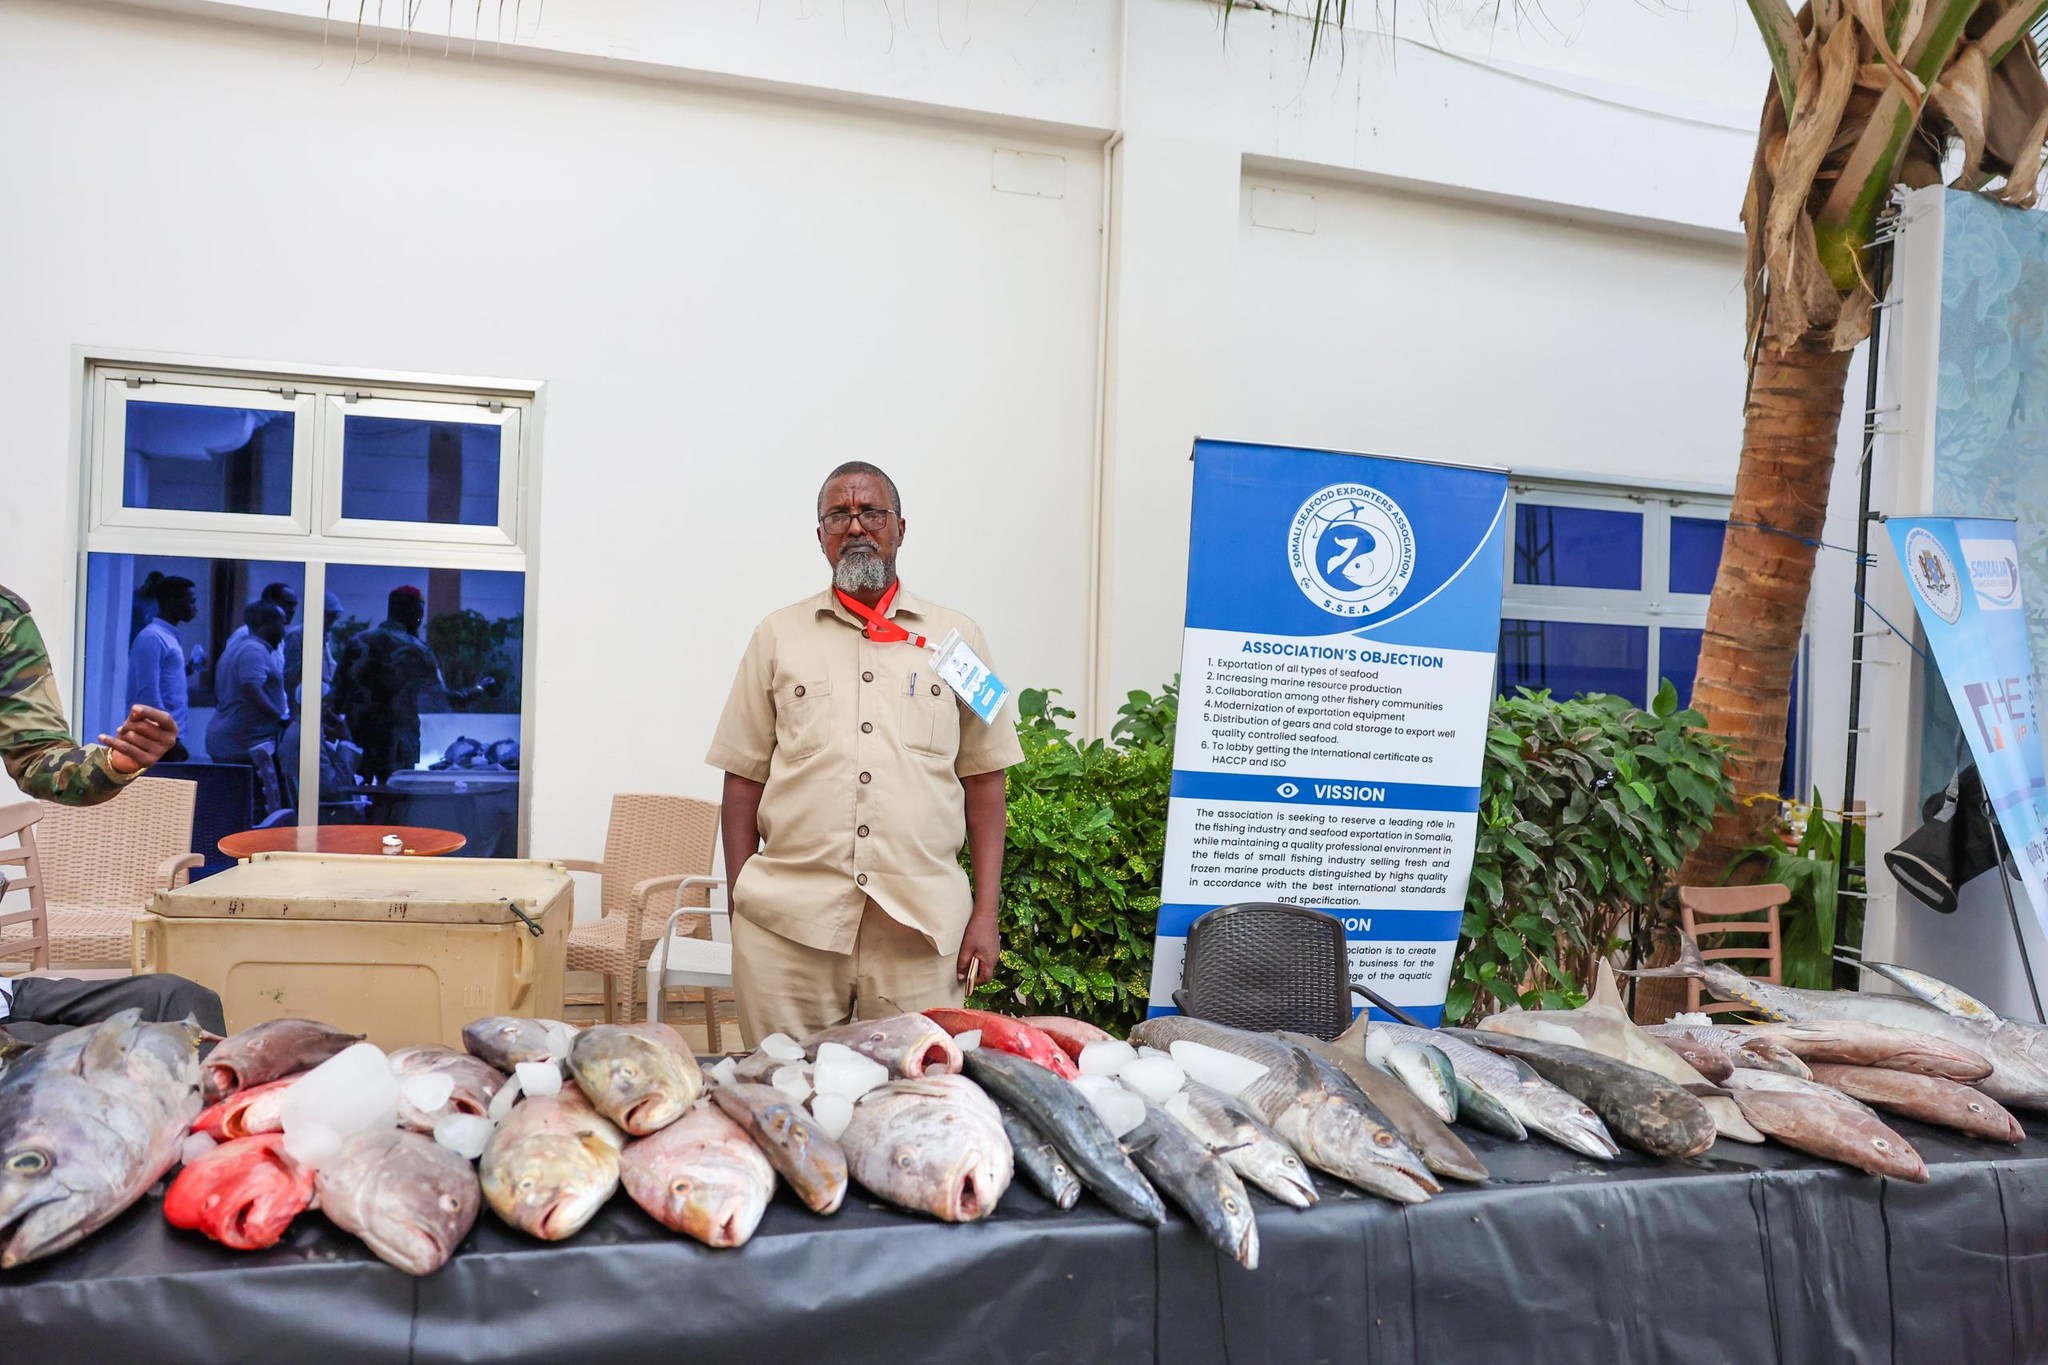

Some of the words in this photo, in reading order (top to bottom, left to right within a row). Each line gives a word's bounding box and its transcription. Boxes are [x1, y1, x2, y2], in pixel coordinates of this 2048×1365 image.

[1292, 527, 1302, 568] SOMALI
[1298, 490, 1335, 526] SEAFOOD
[1336, 487, 1393, 512] EXPORTERS
[1391, 511, 1412, 579] ASSOCIATION
[1971, 559, 2009, 577] SOMALIA
[1323, 599, 1370, 615] S.S.E.A
[1360, 650, 1443, 668] OBJECTION
[1208, 658, 1213, 666] 1.
[1218, 659, 1272, 670] Exportation
[1275, 663, 1284, 672] of
[1301, 666, 1326, 676] types
[1329, 668, 1338, 676] of
[1340, 669, 1378, 679] seafood
[1207, 672, 1214, 680] 2.
[1216, 673, 1268, 687] Increasing
[1271, 678, 1305, 687] marine
[1308, 681, 1348, 690] resource
[1350, 684, 1402, 694] production
[1206, 685, 1213, 694] 3.
[1216, 686, 1282, 698] Collaboration
[1284, 693, 1319, 704] among
[1322, 695, 1345, 703] other
[1348, 696, 1380, 707] fishery
[1382, 700, 1443, 711] communities
[1204, 700, 1213, 708] 4.
[1214, 700, 1283, 712] Modernization
[1286, 705, 1295, 713] of
[1297, 708, 1350, 717] exportation
[1352, 711, 1405, 721] equipment
[1204, 713, 1212, 722] 5.
[1213, 714, 1269, 725] Distribution
[1271, 718, 1280, 726] of
[1283, 720, 1310, 729] gears
[1312, 722, 1331, 730] and
[1333, 723, 1353, 731] cold
[1356, 724, 1392, 736] storage
[1406, 728, 1435, 738] export
[1438, 730, 1455, 738] well
[1212, 728, 1246, 740] quality
[1248, 732, 1296, 741] controlled
[1299, 734, 1338, 743] seafood.
[1201, 740, 1209, 749] 6.
[1213, 742, 1224, 750] To
[1226, 742, 1254, 754] lobby
[1256, 745, 1290, 756] getting
[1293, 747, 1308, 755] the
[1311, 748, 1371, 759] International
[1373, 752, 1420, 762] certificate
[1212, 756, 1247, 765] HACCP
[1249, 758, 1268, 766] and
[1270, 759, 1286, 767] ISO
[1315, 785, 1385, 801] VISSION
[1197, 808, 1214, 817] The
[1218, 810, 1273, 820] association
[1277, 812, 1284, 820] is
[1288, 814, 1325, 825] seeking
[1341, 817, 1376, 825] reserve
[1389, 818, 1423, 830] leading
[1447, 820, 1455, 828] in
[1195, 822, 1211, 831] the
[1213, 823, 1245, 835] fishing
[1248, 824, 1286, 836] industry
[1288, 827, 1308, 835] and
[1310, 828, 1348, 837] seafood
[1350, 831, 1402, 840] exportation
[1404, 832, 1412, 840] in
[1414, 832, 1453, 842] Somalia,
[1194, 836, 1219, 845] while
[1221, 838, 1280, 850] maintaining
[1290, 841, 1324, 852] quality
[1325, 842, 1382, 852] professional
[1384, 845, 1442, 854] environment
[1443, 846, 1452, 854] in
[1192, 850, 1208, 859] the
[1214, 850, 1239, 860] fields
[1244, 852, 1254, 860] of
[1291, 854, 1322, 866] fishing
[1328, 855, 1366, 867] industry
[1370, 858, 1400, 868] selling
[1405, 858, 1427, 867] fresh
[1432, 860, 1450, 868] and
[1191, 864, 1220, 873] frozen
[1224, 865, 1258, 874] marine
[1262, 867, 1305, 876] products
[1308, 868, 1372, 880] distinguished
[1374, 871, 1386, 881] by
[1390, 871, 1414, 882] highs
[1417, 872, 1448, 883] quality
[1189, 878, 1198, 886] in
[1203, 879, 1261, 888] accordance
[1266, 880, 1286, 888] with
[1292, 882, 1308, 890] the
[1312, 882, 1333, 890] best
[1338, 883, 1396, 892] international
[1401, 886, 1446, 894] standards
[1278, 896, 1296, 904] and
[1299, 896, 1361, 905] specification.
[1385, 946, 1392, 954] is
[1359, 959, 1398, 967] business
[1403, 959, 1416, 967] for
[1368, 972, 1377, 980] of
[1380, 972, 1395, 980] the
[1398, 972, 1432, 982] aquatic
